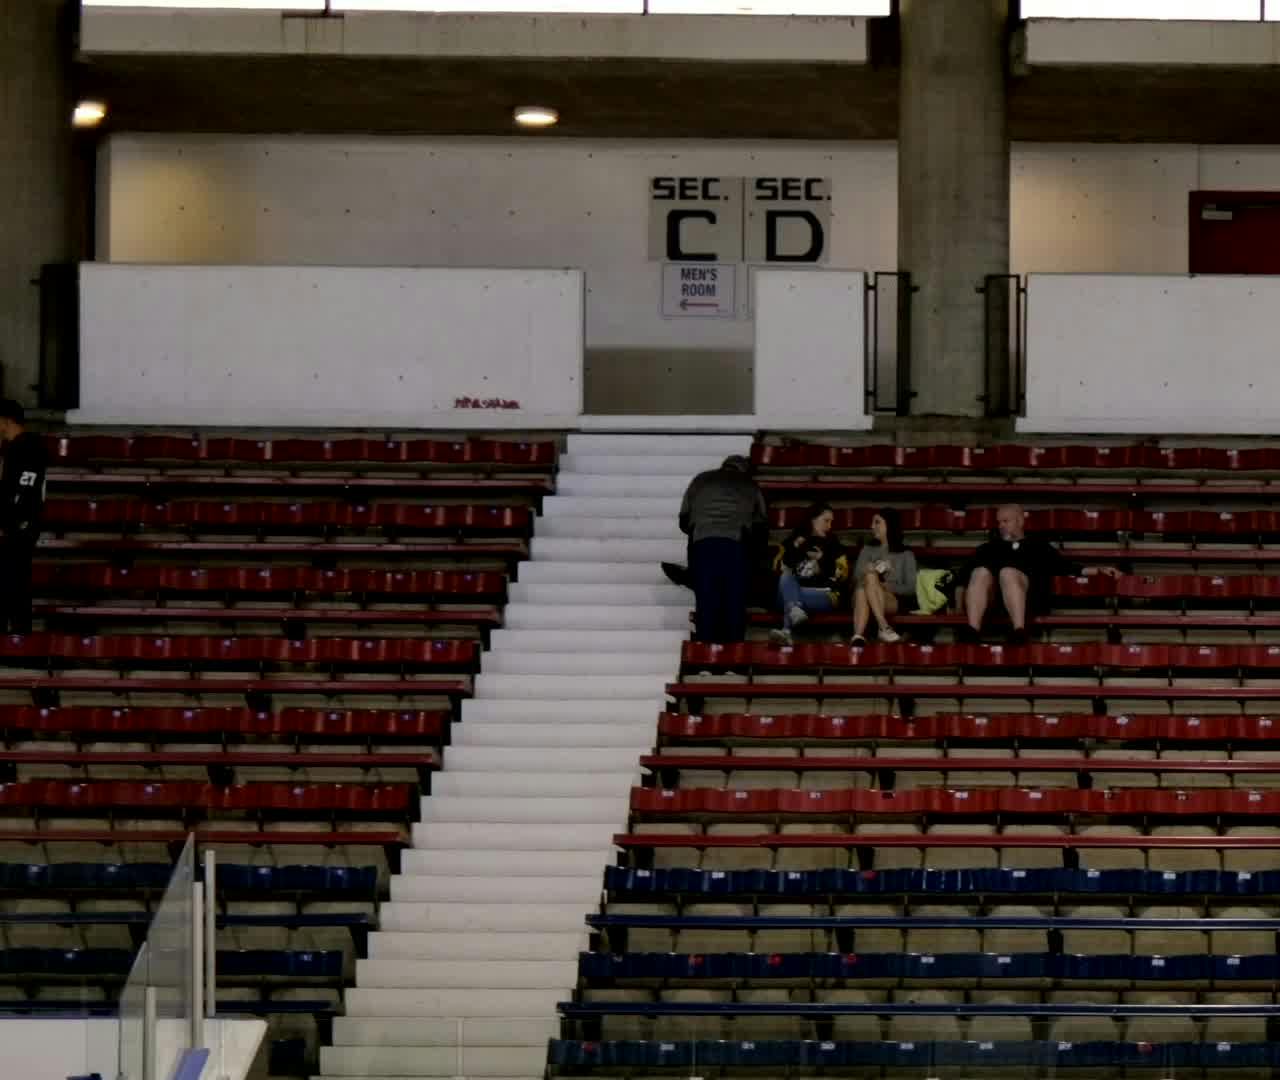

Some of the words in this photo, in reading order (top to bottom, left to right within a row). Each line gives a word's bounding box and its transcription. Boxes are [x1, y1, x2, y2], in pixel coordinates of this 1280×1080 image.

[652, 177, 729, 201] SEC.
[755, 178, 832, 201] SEC.
[666, 209, 718, 262] C
[765, 210, 824, 262] D
[680, 267, 718, 282] MEN'S
[680, 283, 717, 297] ROOM
